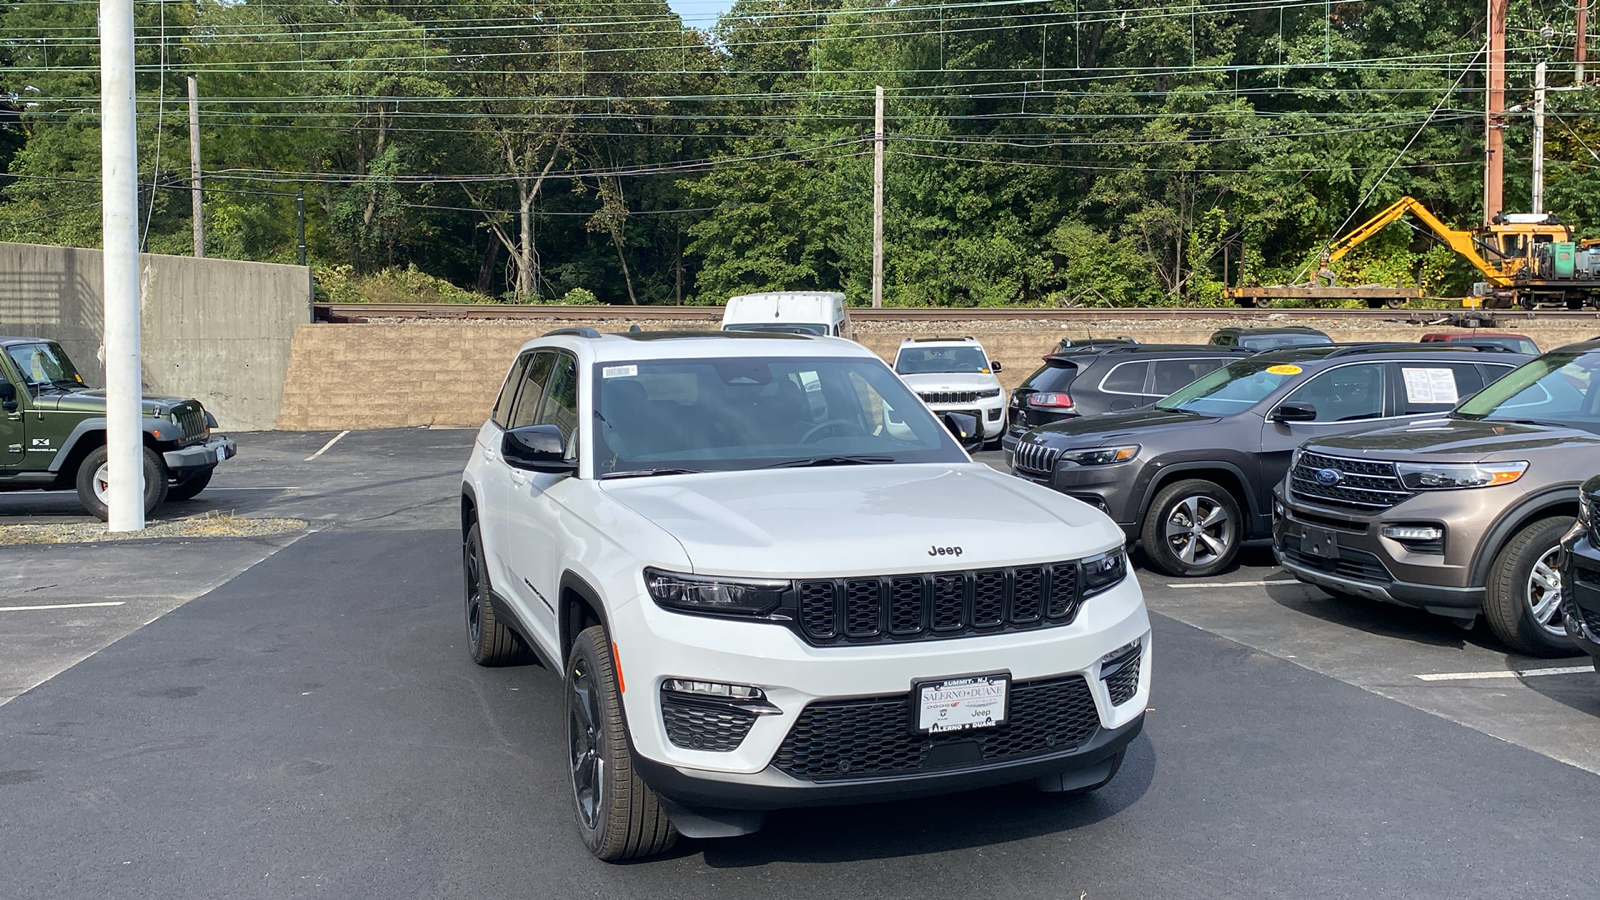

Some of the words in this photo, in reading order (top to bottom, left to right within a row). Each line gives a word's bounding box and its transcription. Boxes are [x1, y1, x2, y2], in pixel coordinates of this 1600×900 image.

[928, 545, 963, 557] Jeep
[923, 689, 966, 702] SALERNO
[970, 686, 1002, 697] DUANE
[971, 709, 991, 718] Jeep
[972, 720, 996, 728] DUANE
